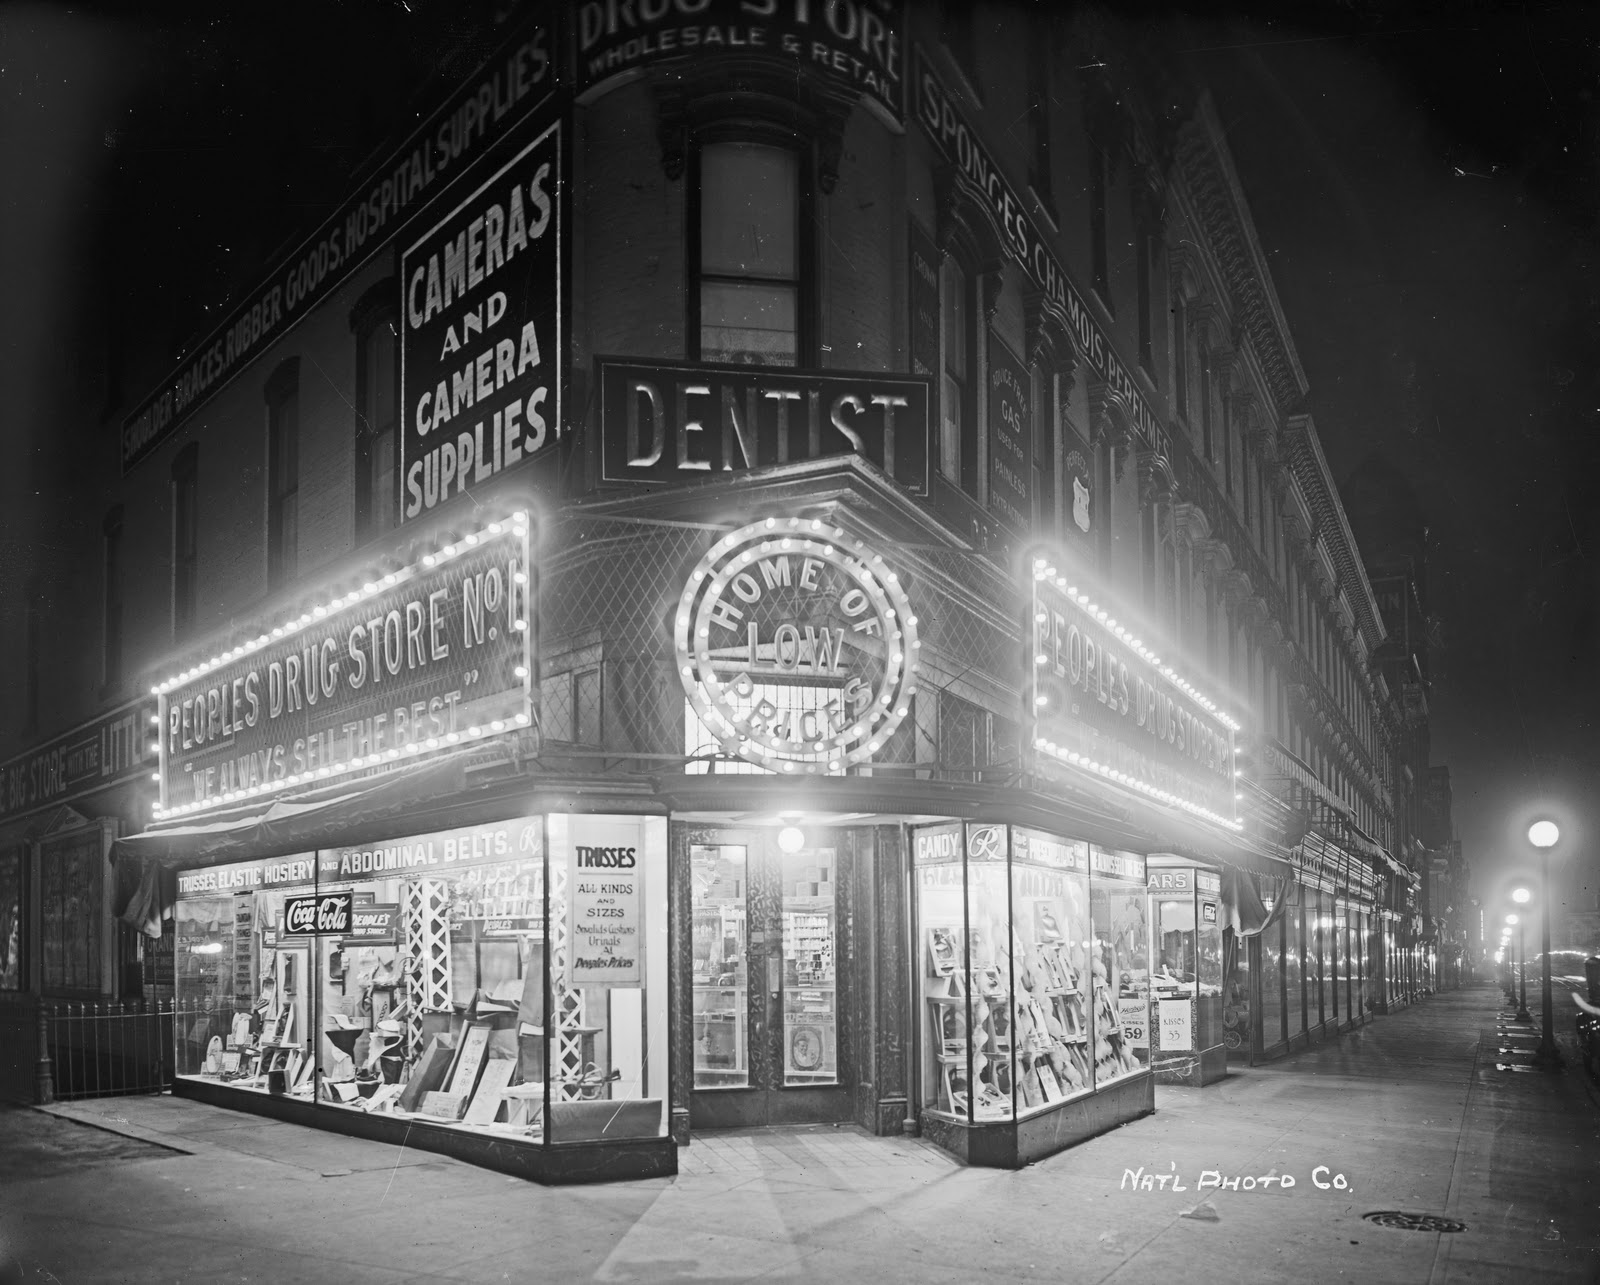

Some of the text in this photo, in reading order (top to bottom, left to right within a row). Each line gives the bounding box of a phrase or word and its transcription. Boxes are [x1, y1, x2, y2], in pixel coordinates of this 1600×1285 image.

[588, 26, 898, 110] WHOLESALE & RETAIL
[123, 388, 172, 461] SHOULDER
[226, 284, 282, 367] RUBBER
[345, 138, 435, 259] HOSPITAL
[437, 27, 548, 171] SUPPLIES
[408, 162, 551, 329] CAMERAS
[441, 291, 508, 360] AND
[416, 320, 541, 437] CAMERA
[1001, 399, 1020, 433] GAS
[1108, 351, 1170, 461] PERFUMES
[406, 386, 548, 519] SUPPLIES
[627, 383, 910, 477] DENTIST
[997, 427, 1024, 462] USED FOR
[995, 457, 1026, 498] PAINLESS
[709, 555, 882, 637] HOME OF
[169, 672, 259, 754] PEOPLES
[269, 637, 338, 718] DRUG
[349, 588, 449, 690] STORE
[748, 621, 845, 672] LOW
[1036, 599, 1129, 716] PEOPLES
[1136, 676, 1176, 744] DRUG
[1177, 706, 1214, 769] STORE
[721, 672, 873, 742] PRICES
[9, 765, 26, 810] BIG
[31, 745, 67, 801] STORE
[85, 743, 98, 769] THE
[102, 707, 152, 776] LITTLE
[219, 745, 285, 793] ALWAYS
[293, 729, 337, 774] SELL
[342, 711, 387, 759] THE
[178, 831, 513, 893] TRUSSES, ELASTIC HOSIERY AND ABDOMINAL BELTS.
[575, 846, 636, 868] TRUSSES
[918, 833, 959, 859] CANDY
[578, 884, 633, 894] ALL KINDS
[586, 908, 625, 917] SIZES
[589, 935, 621, 946] Urinals
